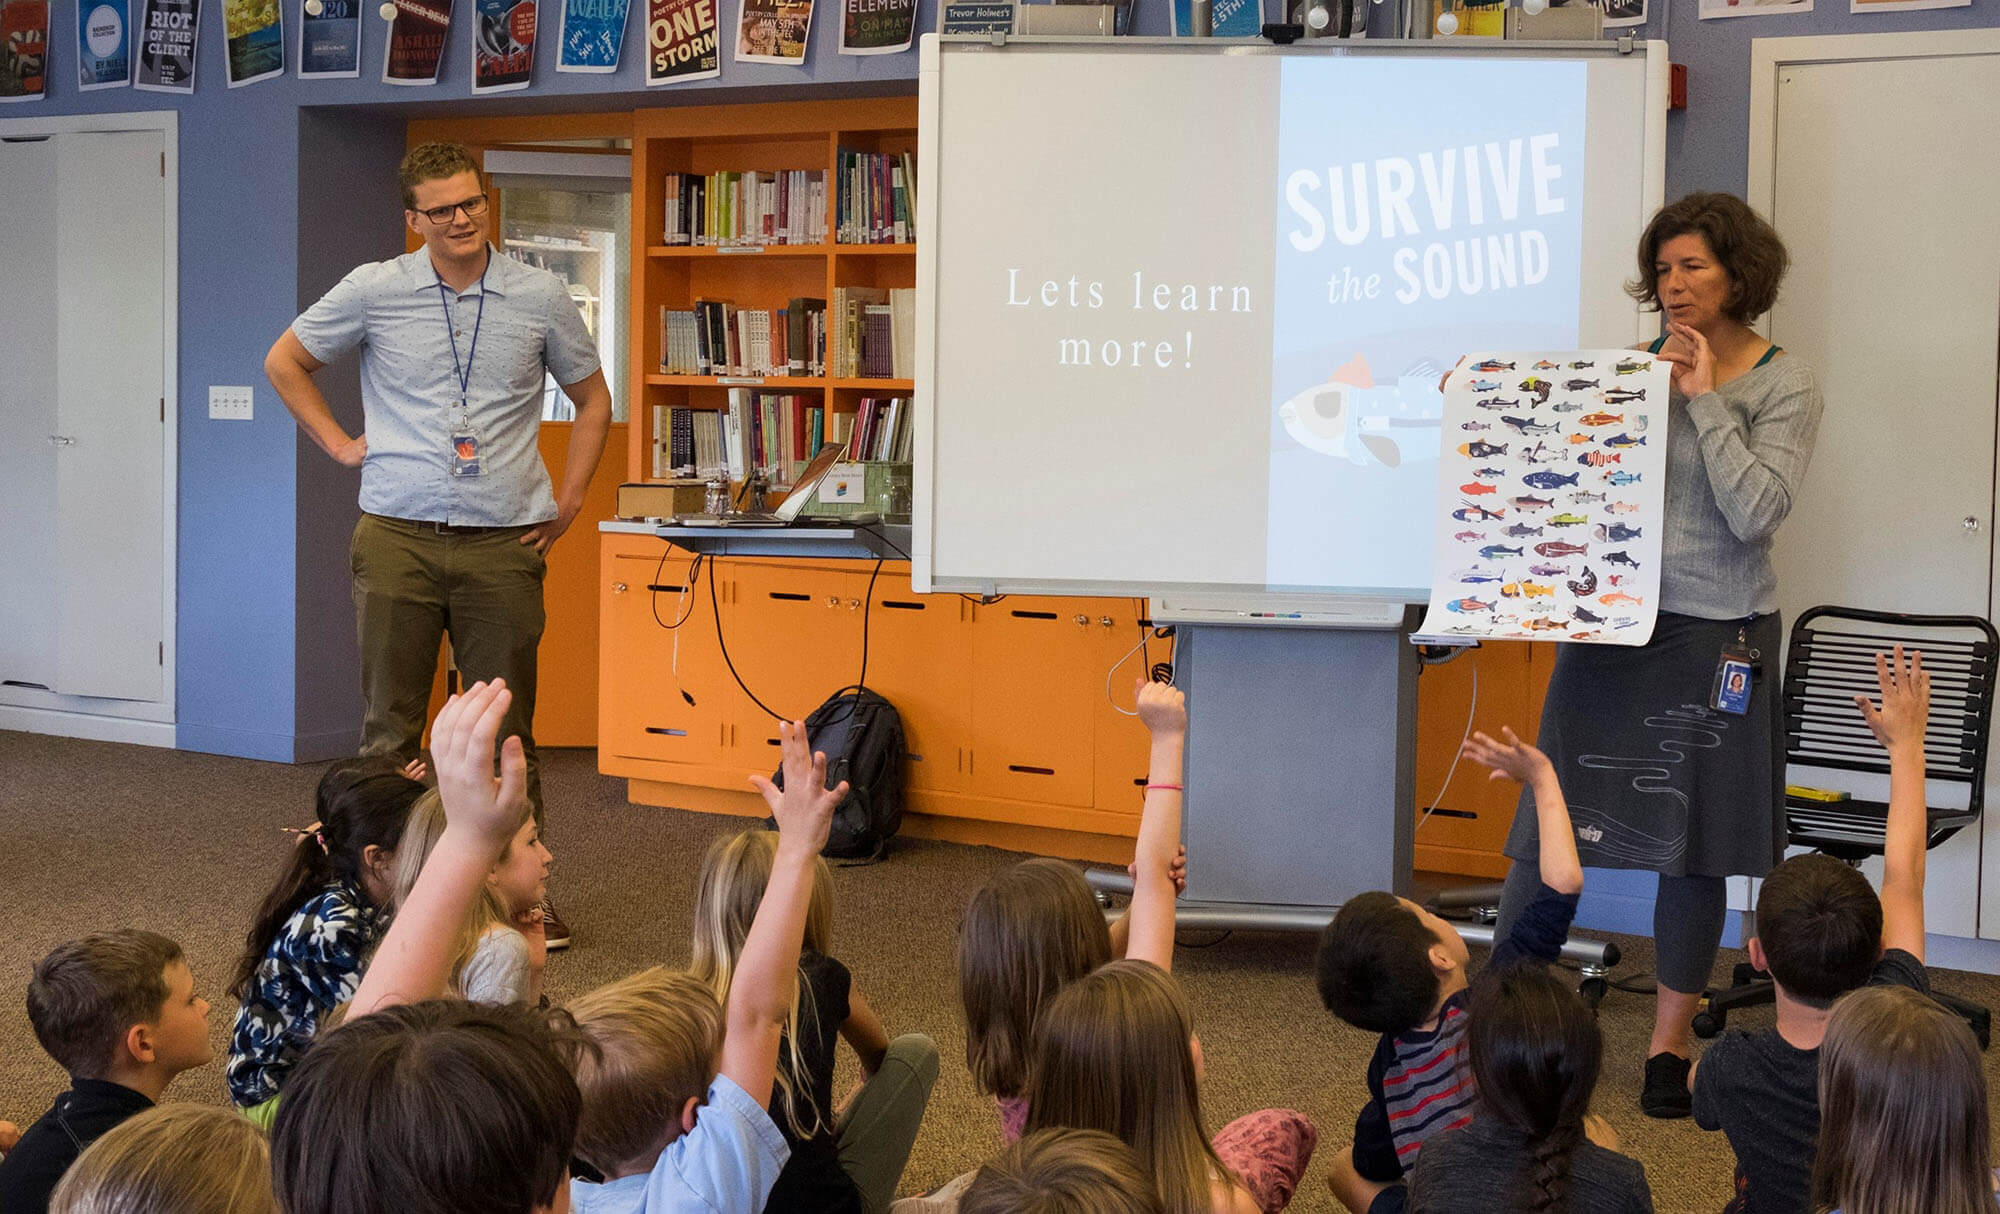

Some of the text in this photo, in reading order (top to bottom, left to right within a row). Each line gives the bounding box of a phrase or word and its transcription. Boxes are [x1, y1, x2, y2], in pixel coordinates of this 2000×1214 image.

[151, 11, 193, 29] RIOT
[650, 0, 714, 49] ONE
[949, 9, 975, 18] Trevor
[148, 42, 191, 57] CLIENT
[150, 29, 191, 43] OF THE
[655, 30, 718, 71] STORM
[1285, 133, 1566, 252] SURVIVE
[1327, 229, 1550, 305] the SOUND
[1006, 268, 1253, 312] Lets learn
[1058, 331, 1194, 368] more!
